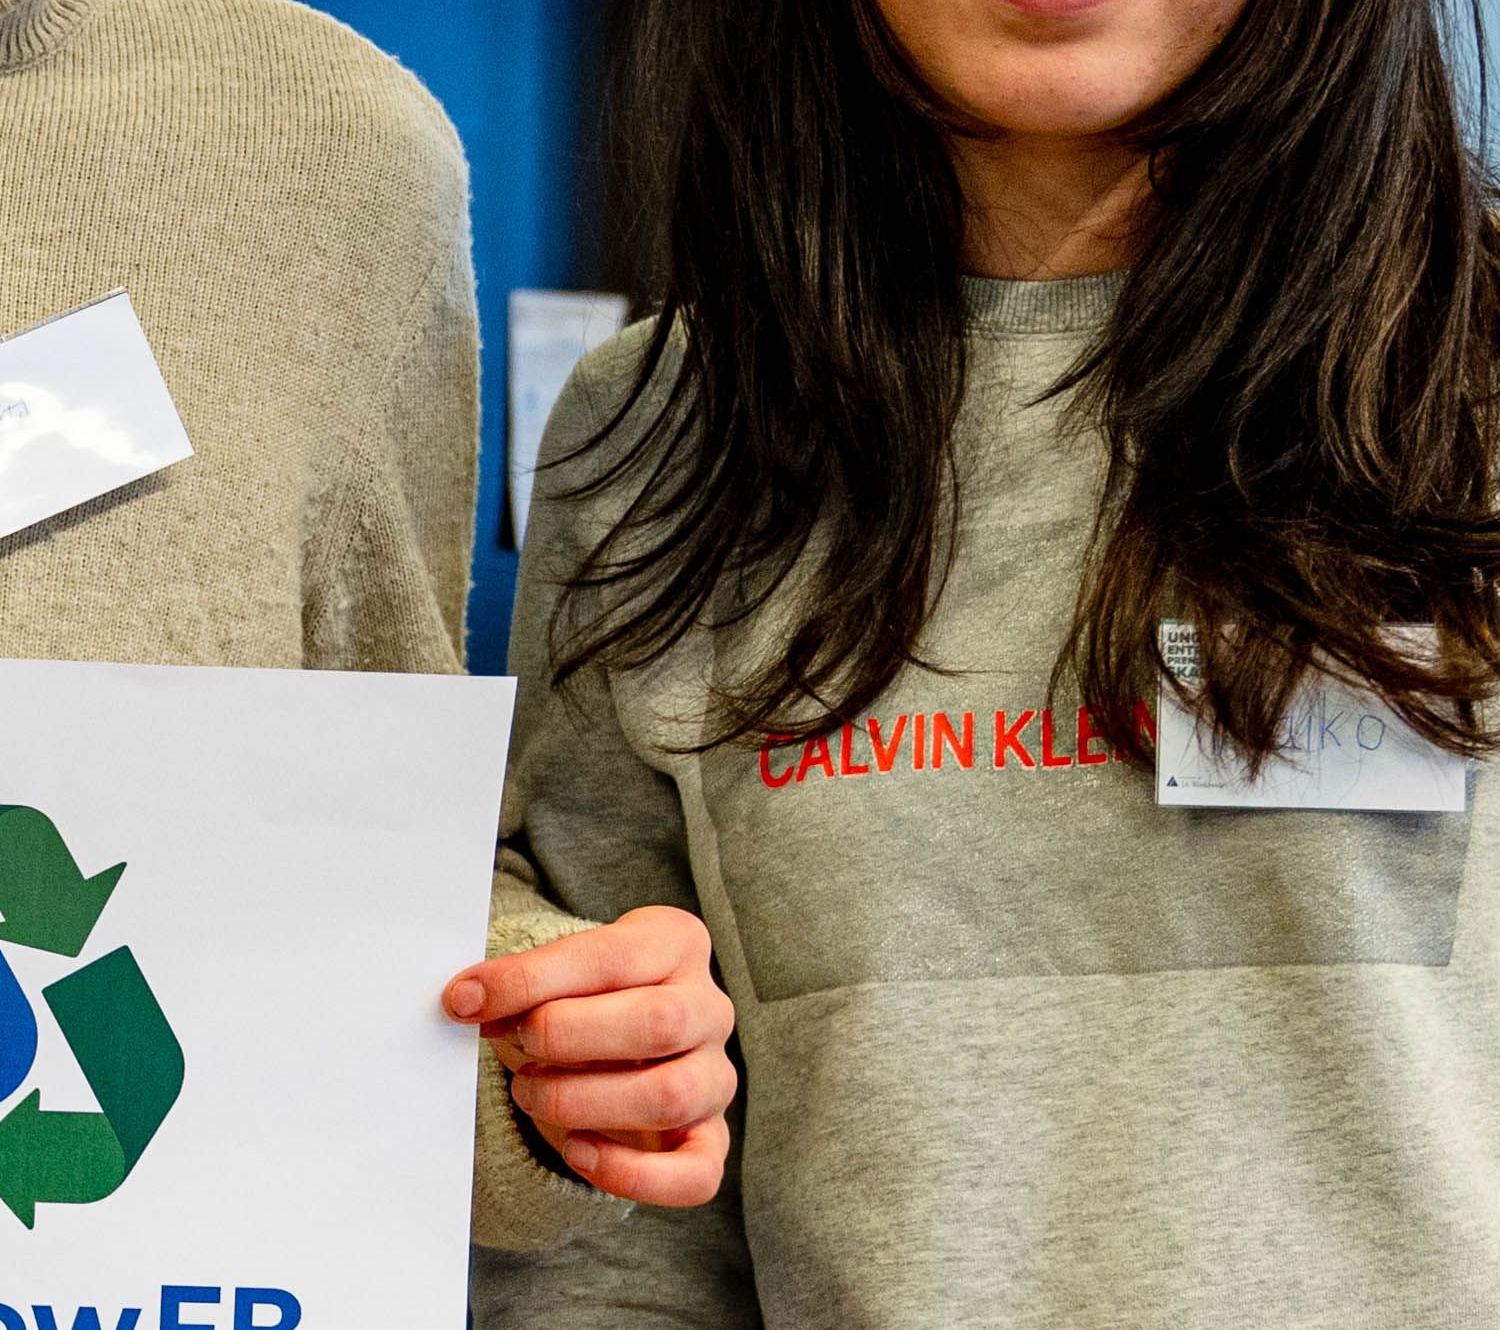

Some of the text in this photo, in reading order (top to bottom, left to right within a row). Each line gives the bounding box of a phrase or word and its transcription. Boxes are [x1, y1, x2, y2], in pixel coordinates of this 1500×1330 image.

[1168, 631, 1200, 644] UN
[1168, 644, 1200, 656] ENT
[1168, 656, 1199, 666] PREN
[759, 700, 1158, 789] CALVIN KLE
